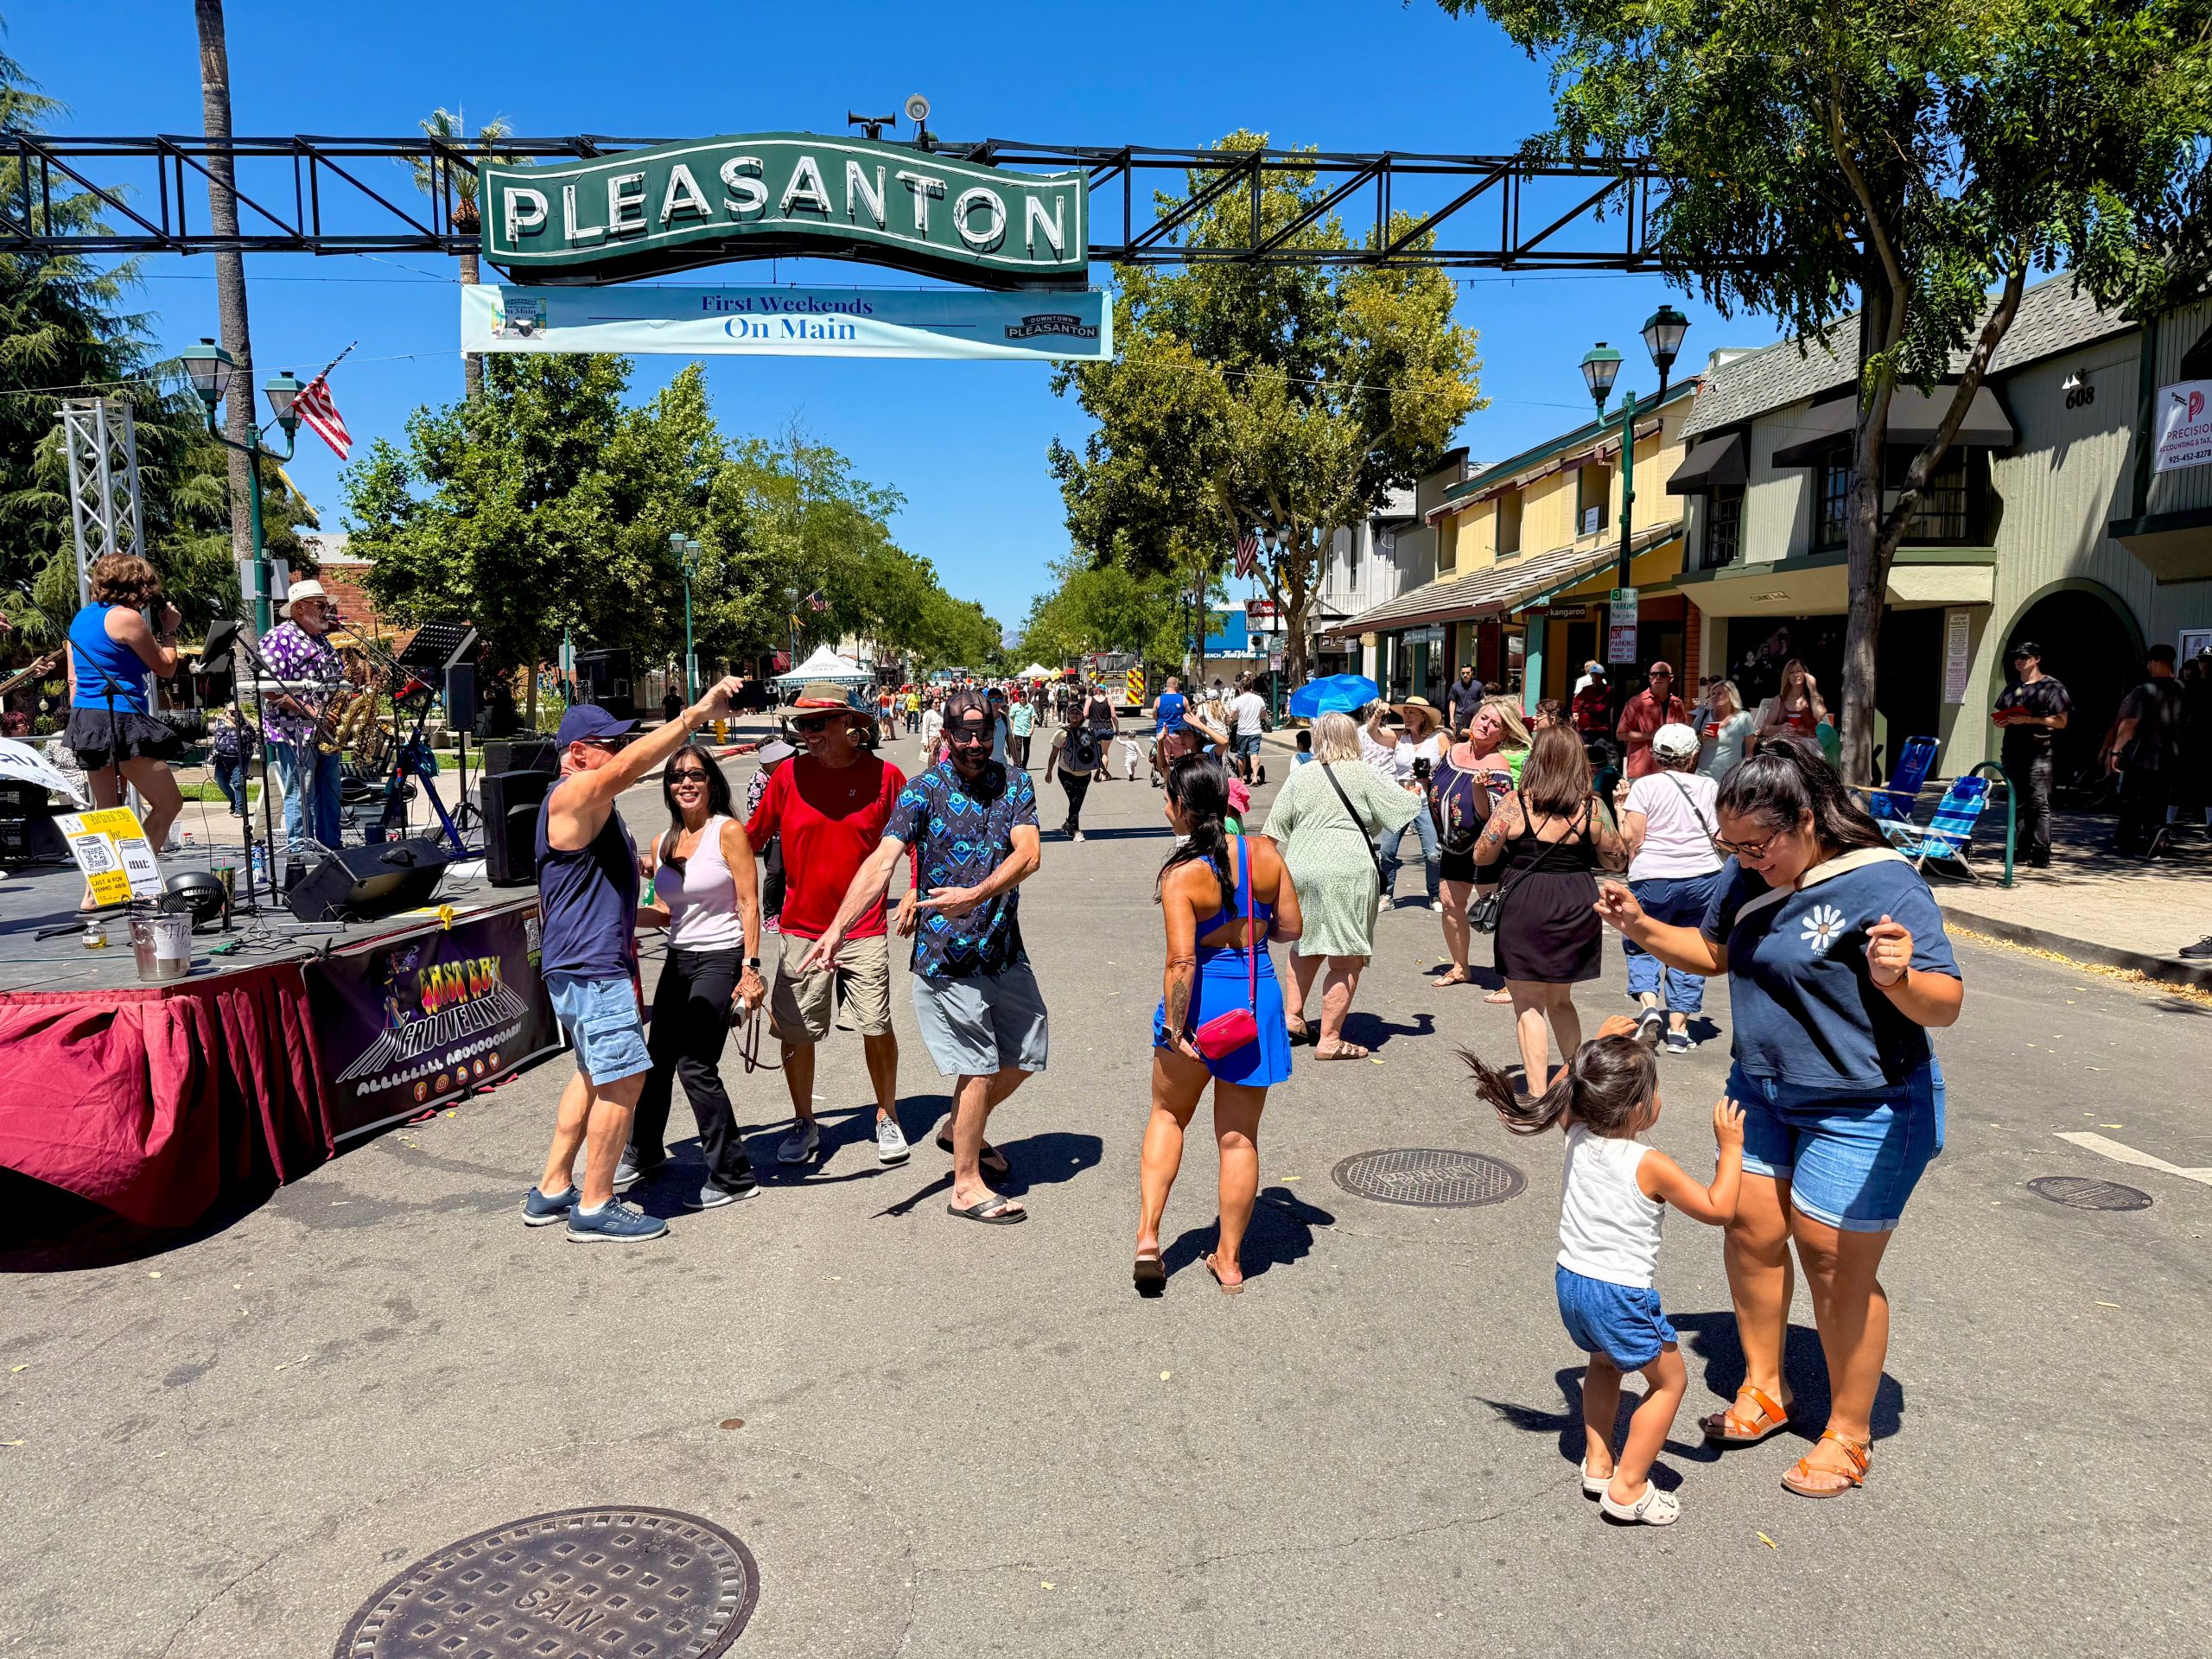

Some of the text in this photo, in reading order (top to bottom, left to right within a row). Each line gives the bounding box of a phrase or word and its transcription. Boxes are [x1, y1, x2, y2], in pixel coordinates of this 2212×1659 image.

[503, 156, 1065, 251] PLEASANTON
[701, 296, 873, 315] First Weekends
[724, 317, 858, 340] On Main
[1008, 324, 1096, 337] PLEASANTON
[2065, 386, 2094, 410] 608
[2158, 439, 2194, 453] ACCOUNTING
[2169, 448, 2212, 464] 925-452-8278
[1613, 590, 1637, 600] 3 HOUR
[1550, 608, 1586, 618] kangaroo
[1611, 630, 1621, 639] NO
[92, 885, 113, 893] VENMO
[418, 960, 468, 1016] EAST
[395, 994, 516, 1063] GROOVELINE
[514, 1588, 604, 1633] SAN
